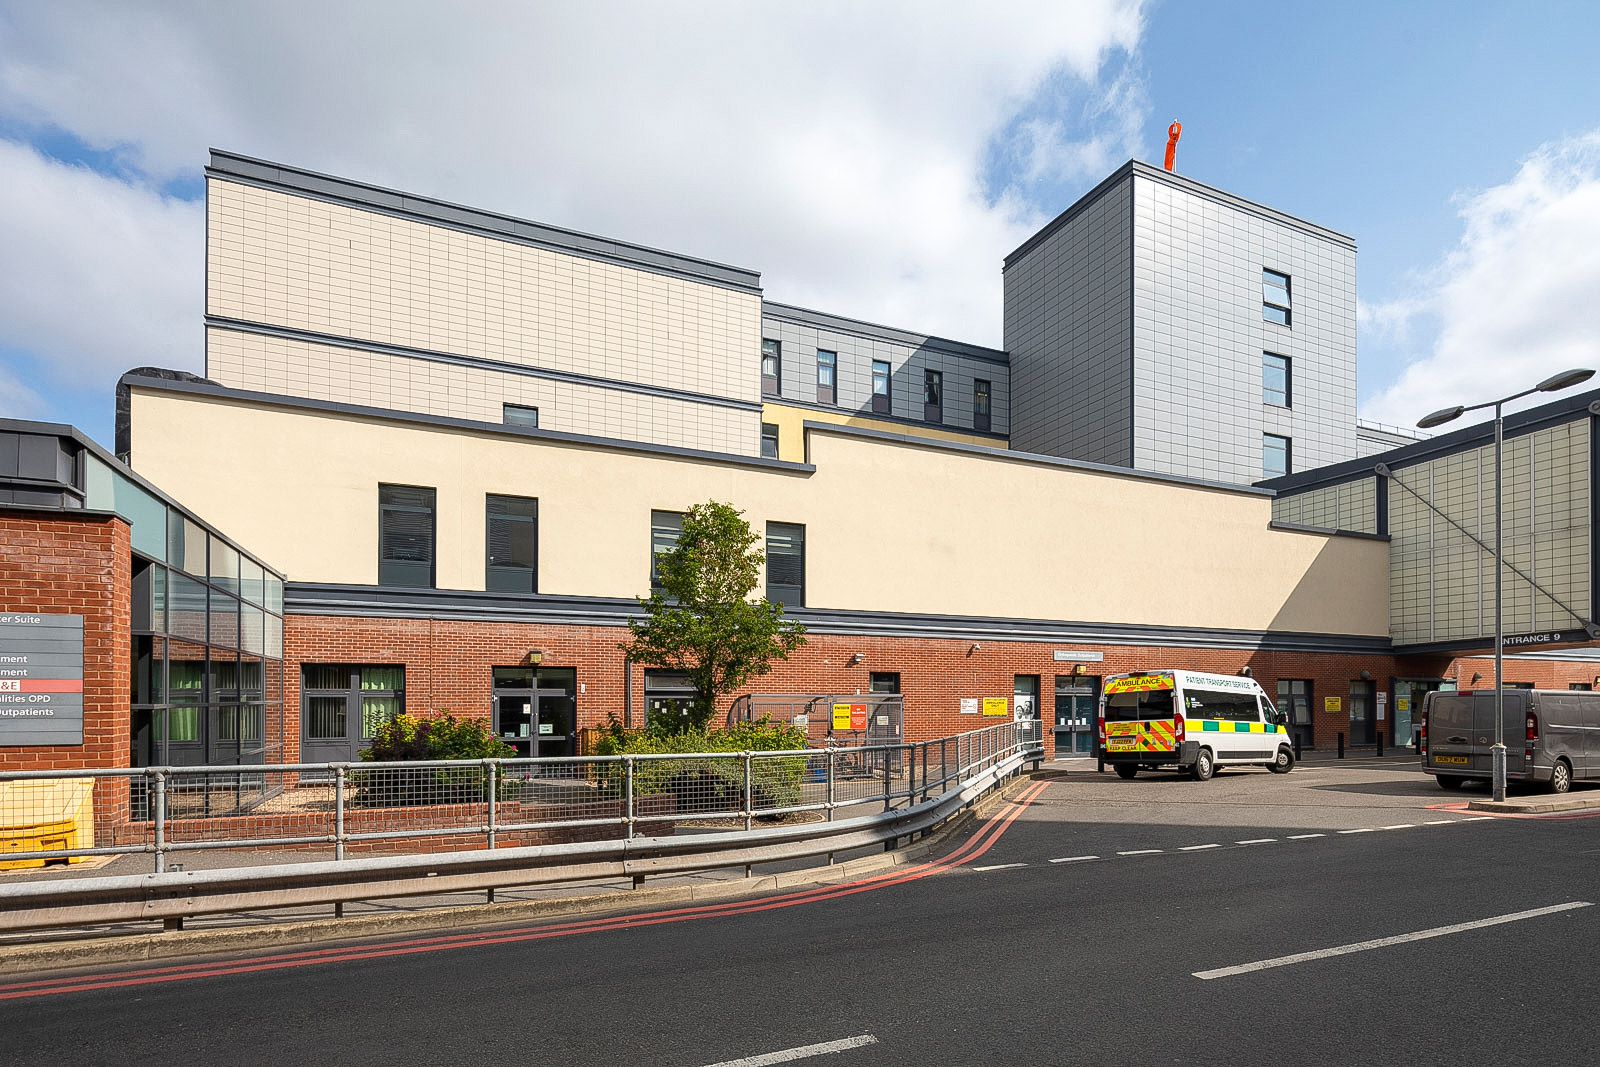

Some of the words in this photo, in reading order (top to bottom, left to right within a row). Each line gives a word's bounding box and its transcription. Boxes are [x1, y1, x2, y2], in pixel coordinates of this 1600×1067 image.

[15, 615, 41, 624] Suite
[1501, 634, 1550, 645] NTRANCE
[1554, 633, 1561, 641] 9
[0, 655, 28, 663] ment
[1116, 678, 1161, 687] AMBULANCE
[1186, 676, 1206, 684] PATIENT
[1206, 678, 1232, 687] TRANSPORT
[1232, 681, 1251, 689] SERVICE
[0, 695, 25, 703] lities
[28, 695, 51, 703] OPD
